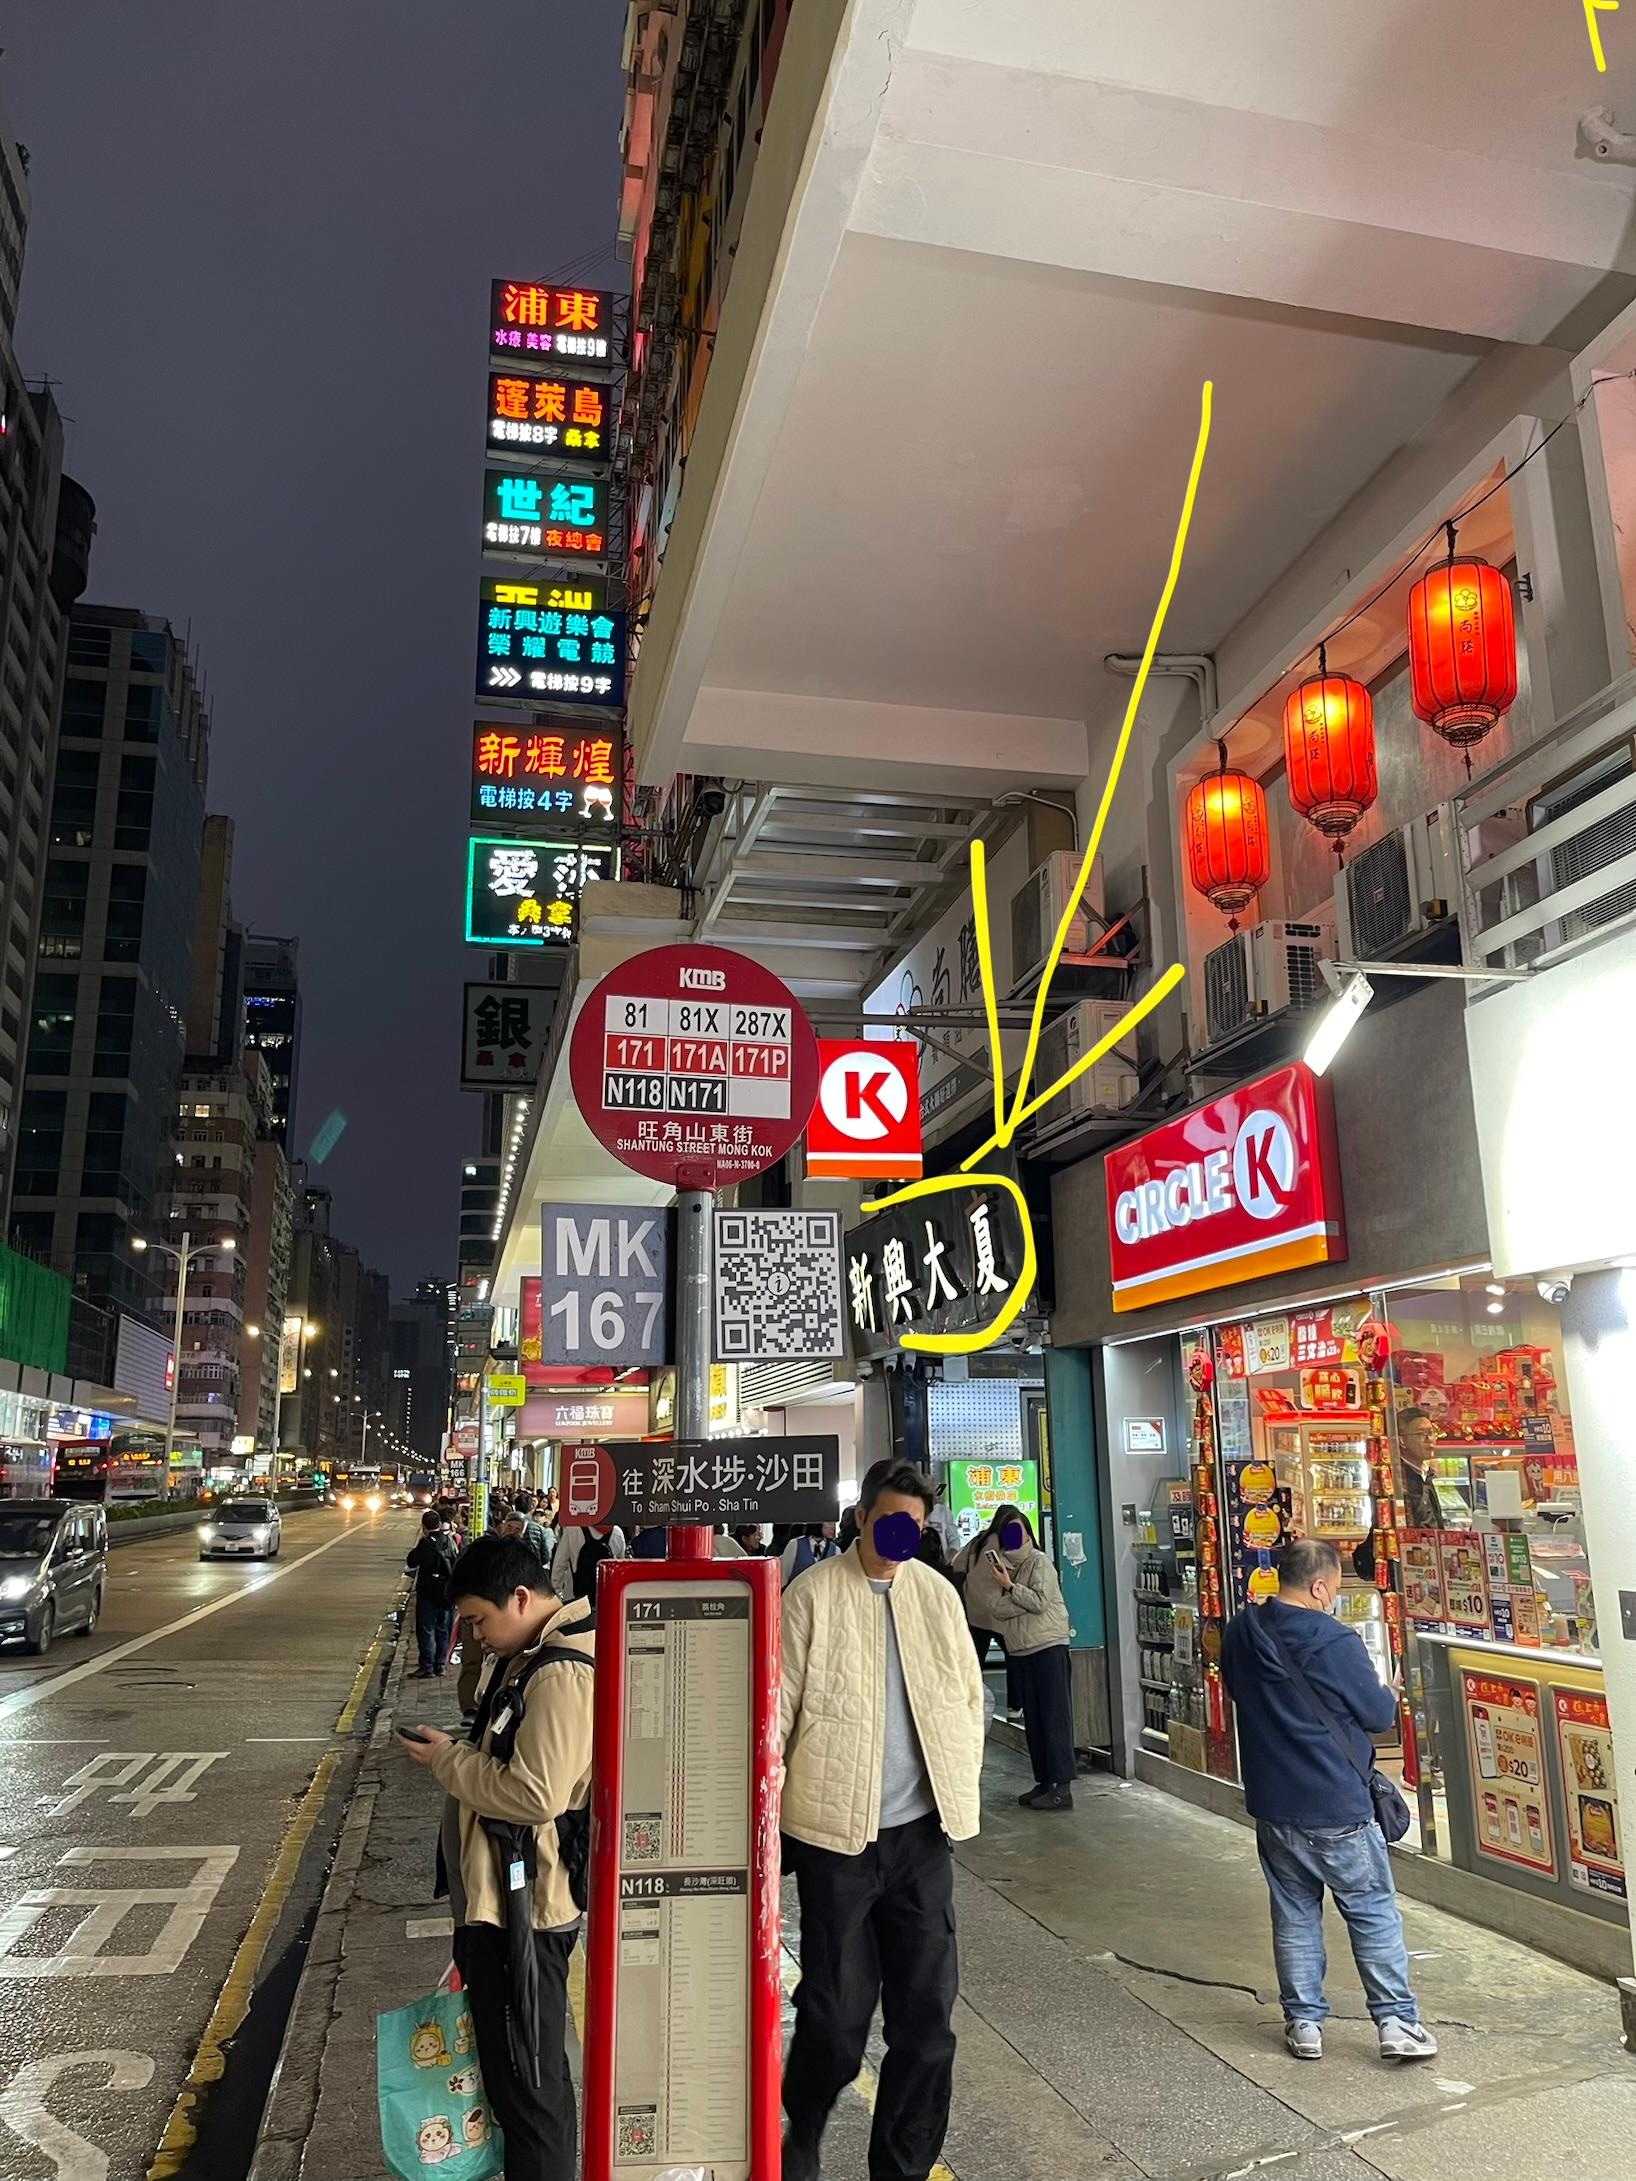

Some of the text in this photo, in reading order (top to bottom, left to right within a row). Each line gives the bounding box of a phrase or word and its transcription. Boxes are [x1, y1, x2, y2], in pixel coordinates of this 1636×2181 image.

[504, 284, 600, 331] 浦東
[526, 332, 552, 351] 美容
[496, 379, 603, 427] 蓬萊島
[492, 419, 558, 445] 電梯按8字
[497, 478, 596, 526] 世紀
[546, 529, 602, 552] 夜總會
[487, 607, 615, 639] 新興遊樂會
[487, 632, 616, 664] 榮耀電競
[530, 670, 612, 694] 電梯按9字
[478, 731, 615, 785] 新輝煌
[479, 784, 573, 812] 電梯按4字
[679, 967, 727, 991] KMB
[625, 1002, 649, 1029] 81
[680, 1006, 719, 1034] 81X
[735, 1010, 787, 1038] 287X
[616, 1039, 653, 1067] 171
[672, 1040, 726, 1071] 171A
[735, 1046, 787, 1075] 171P
[607, 1076, 662, 1107] N118
[670, 1080, 723, 1109] N171
[637, 1120, 754, 1145] 旺角山東街
[616, 1138, 773, 1158] SHANTUNG STREET MONG KOK
[1115, 1150, 1234, 1245] CIRCLE
[555, 1217, 658, 1278] MK
[849, 1188, 1010, 1334] 新興大廈
[550, 1290, 664, 1350] 167
[555, 1405, 615, 1421] 六福珠寶
[575, 1447, 597, 1459] KMB
[450, 1469, 465, 1477] 166
[622, 1468, 643, 1497] 往
[968, 1465, 1023, 1487] 浦東
[632, 1501, 643, 1513] To
[649, 1500, 671, 1513] Sham
[671, 1499, 692, 1512] Shui
[694, 1499, 709, 1512] Po
[719, 1499, 740, 1512] Sha
[743, 1498, 759, 1511] Tin
[633, 1602, 662, 1619] 171
[1463, 1594, 1483, 1614] $10
[1508, 1758, 1529, 1778] $20
[621, 1877, 665, 1896] N118
